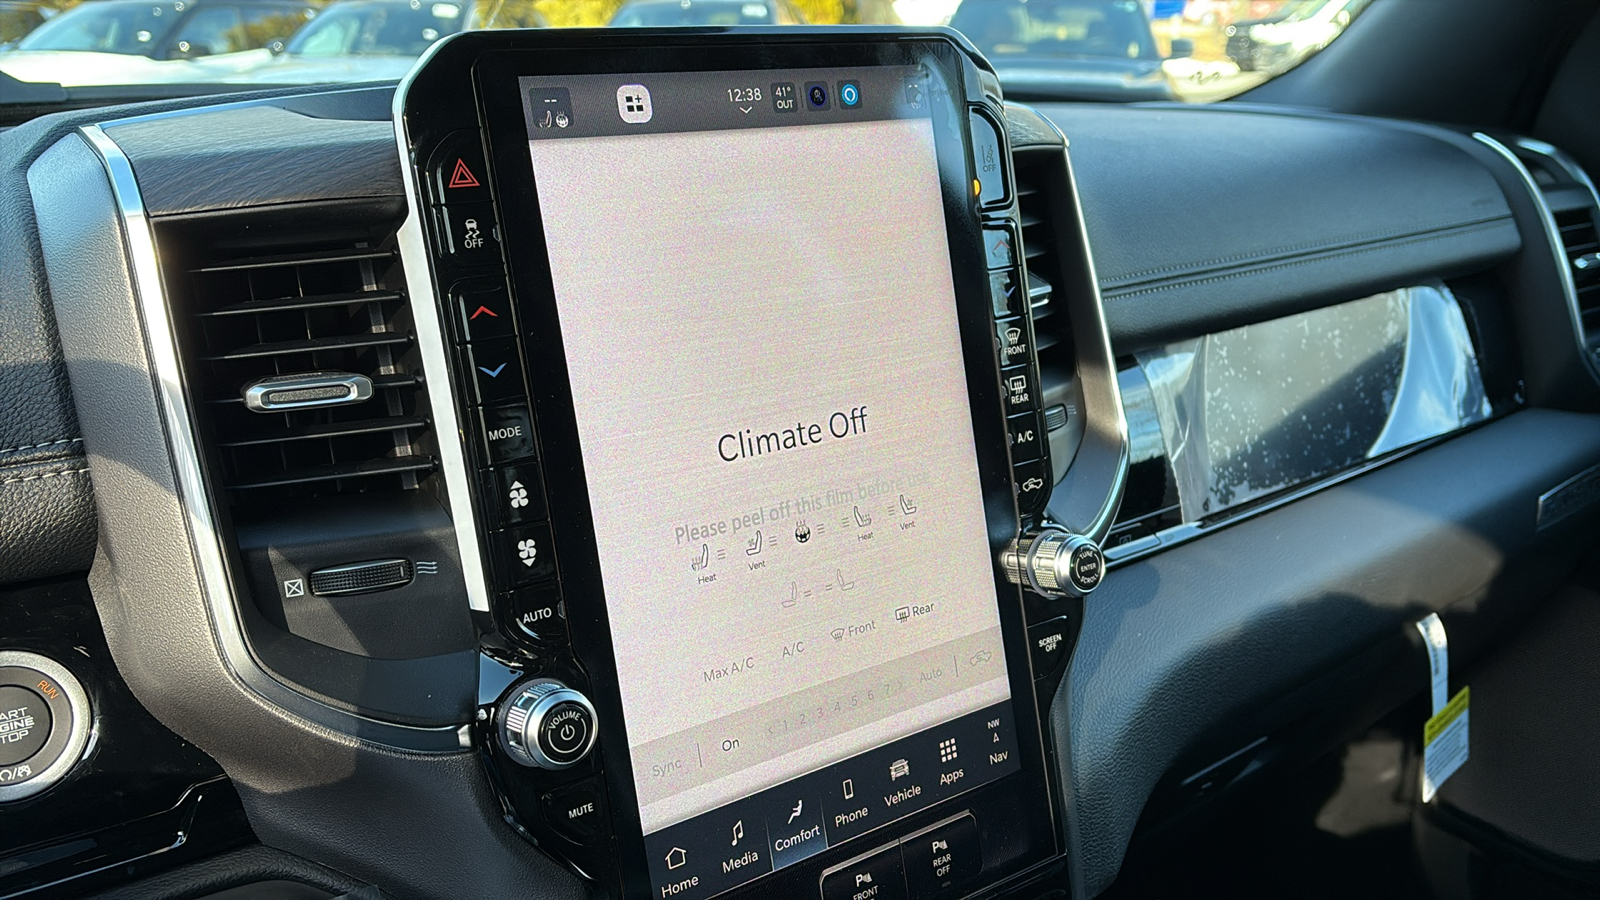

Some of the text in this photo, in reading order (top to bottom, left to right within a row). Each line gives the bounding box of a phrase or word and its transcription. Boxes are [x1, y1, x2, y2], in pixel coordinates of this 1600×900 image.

[727, 88, 762, 102] 12:38
[776, 99, 794, 109] OUT
[983, 164, 996, 172] OFF
[464, 238, 484, 249] OFF
[1003, 344, 1026, 355] FRONT
[1011, 393, 1029, 404] REAR
[488, 426, 522, 441] MODE
[717, 405, 868, 462] Climate Off
[1017, 430, 1034, 443] A/C
[675, 520, 727, 545] Please
[732, 507, 764, 534] peel
[769, 499, 791, 521] off
[795, 495, 822, 515] this
[826, 487, 855, 507] film
[857, 478, 903, 500] before
[900, 521, 916, 530] Vent
[857, 531, 874, 541] Heat
[1079, 550, 1093, 559] TUNE
[748, 560, 766, 571] Vent
[1080, 562, 1097, 572] ENTER
[697, 573, 717, 585] Heat
[1080, 573, 1098, 584] SCROLL
[522, 607, 552, 624] AUTO
[912, 601, 935, 617] Rear
[848, 619, 876, 637] Front
[1038, 633, 1062, 647] SCREEN
[781, 640, 806, 659] A/C
[1045, 643, 1057, 653] OFF
[703, 656, 756, 684] Max A/C
[919, 668, 942, 683] Auto
[37, 680, 59, 699] RUN
[800, 713, 807, 725] 2
[817, 707, 824, 719] 3
[834, 701, 842, 713] 4
[851, 695, 858, 707] 5
[868, 689, 875, 701] 6
[884, 684, 891, 695] 7
[0, 706, 28, 720] ART
[548, 710, 581, 730] VOLUME
[0, 716, 35, 732] GINE
[987, 717, 1001, 729] NW
[0, 729, 29, 744] TOP
[721, 737, 740, 752] On
[989, 750, 1008, 766] Nav
[652, 758, 682, 778] Sync
[939, 767, 964, 786] Apps
[883, 784, 922, 808] Vehicle
[568, 802, 594, 819] MUTE
[834, 806, 869, 828] Phone
[775, 824, 821, 852] Comfort
[722, 850, 759, 874] Media
[933, 853, 951, 867] REAR
[936, 864, 951, 877] OFF
[661, 873, 699, 899] Home
[853, 885, 879, 900] FRONT
